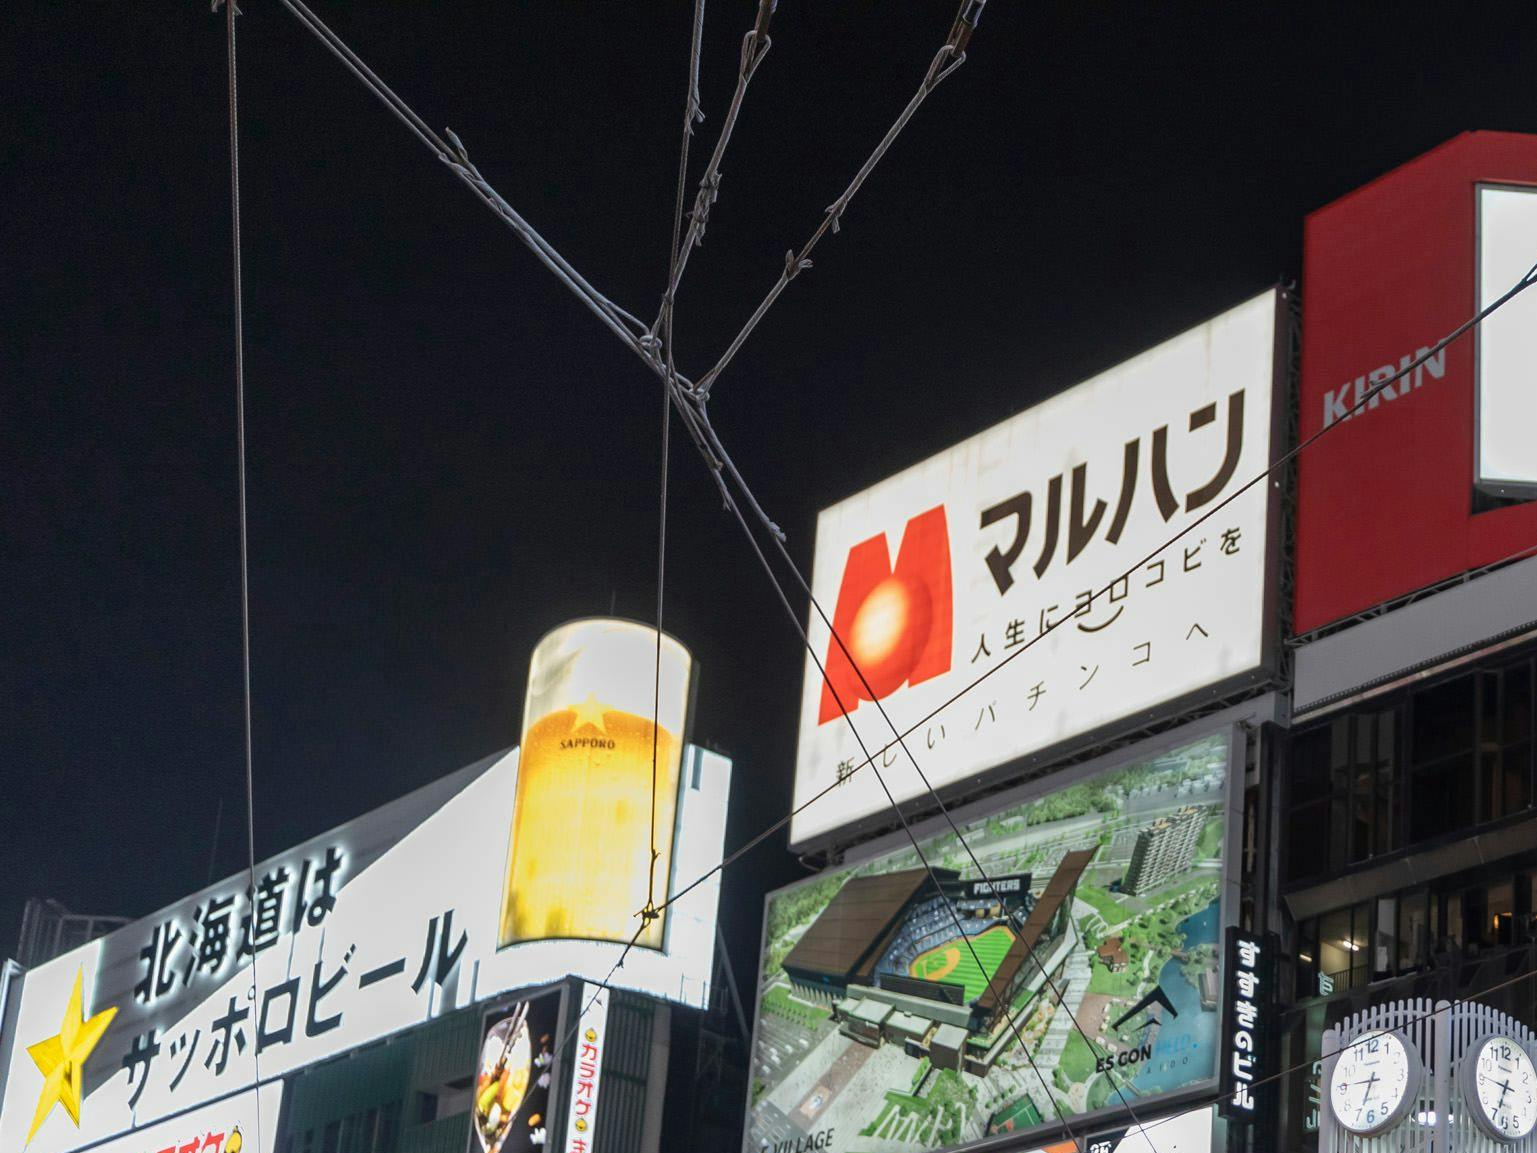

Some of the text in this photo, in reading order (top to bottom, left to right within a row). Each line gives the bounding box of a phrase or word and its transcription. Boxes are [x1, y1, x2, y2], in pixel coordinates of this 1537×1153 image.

[1322, 343, 1447, 429] KIRIN
[980, 388, 1245, 595] マルハン
[971, 527, 1242, 663] 人生にヨロコビを
[558, 737, 616, 752] SAPPORO
[836, 621, 1210, 787] 新しいパチンコへ
[134, 847, 345, 1003] 北海道は
[973, 877, 1021, 896] FIGHTERS
[121, 909, 469, 1108] サッポロビール
[576, 1043, 599, 1117] カラオケ
[1233, 940, 1262, 1110] すすきのビル
